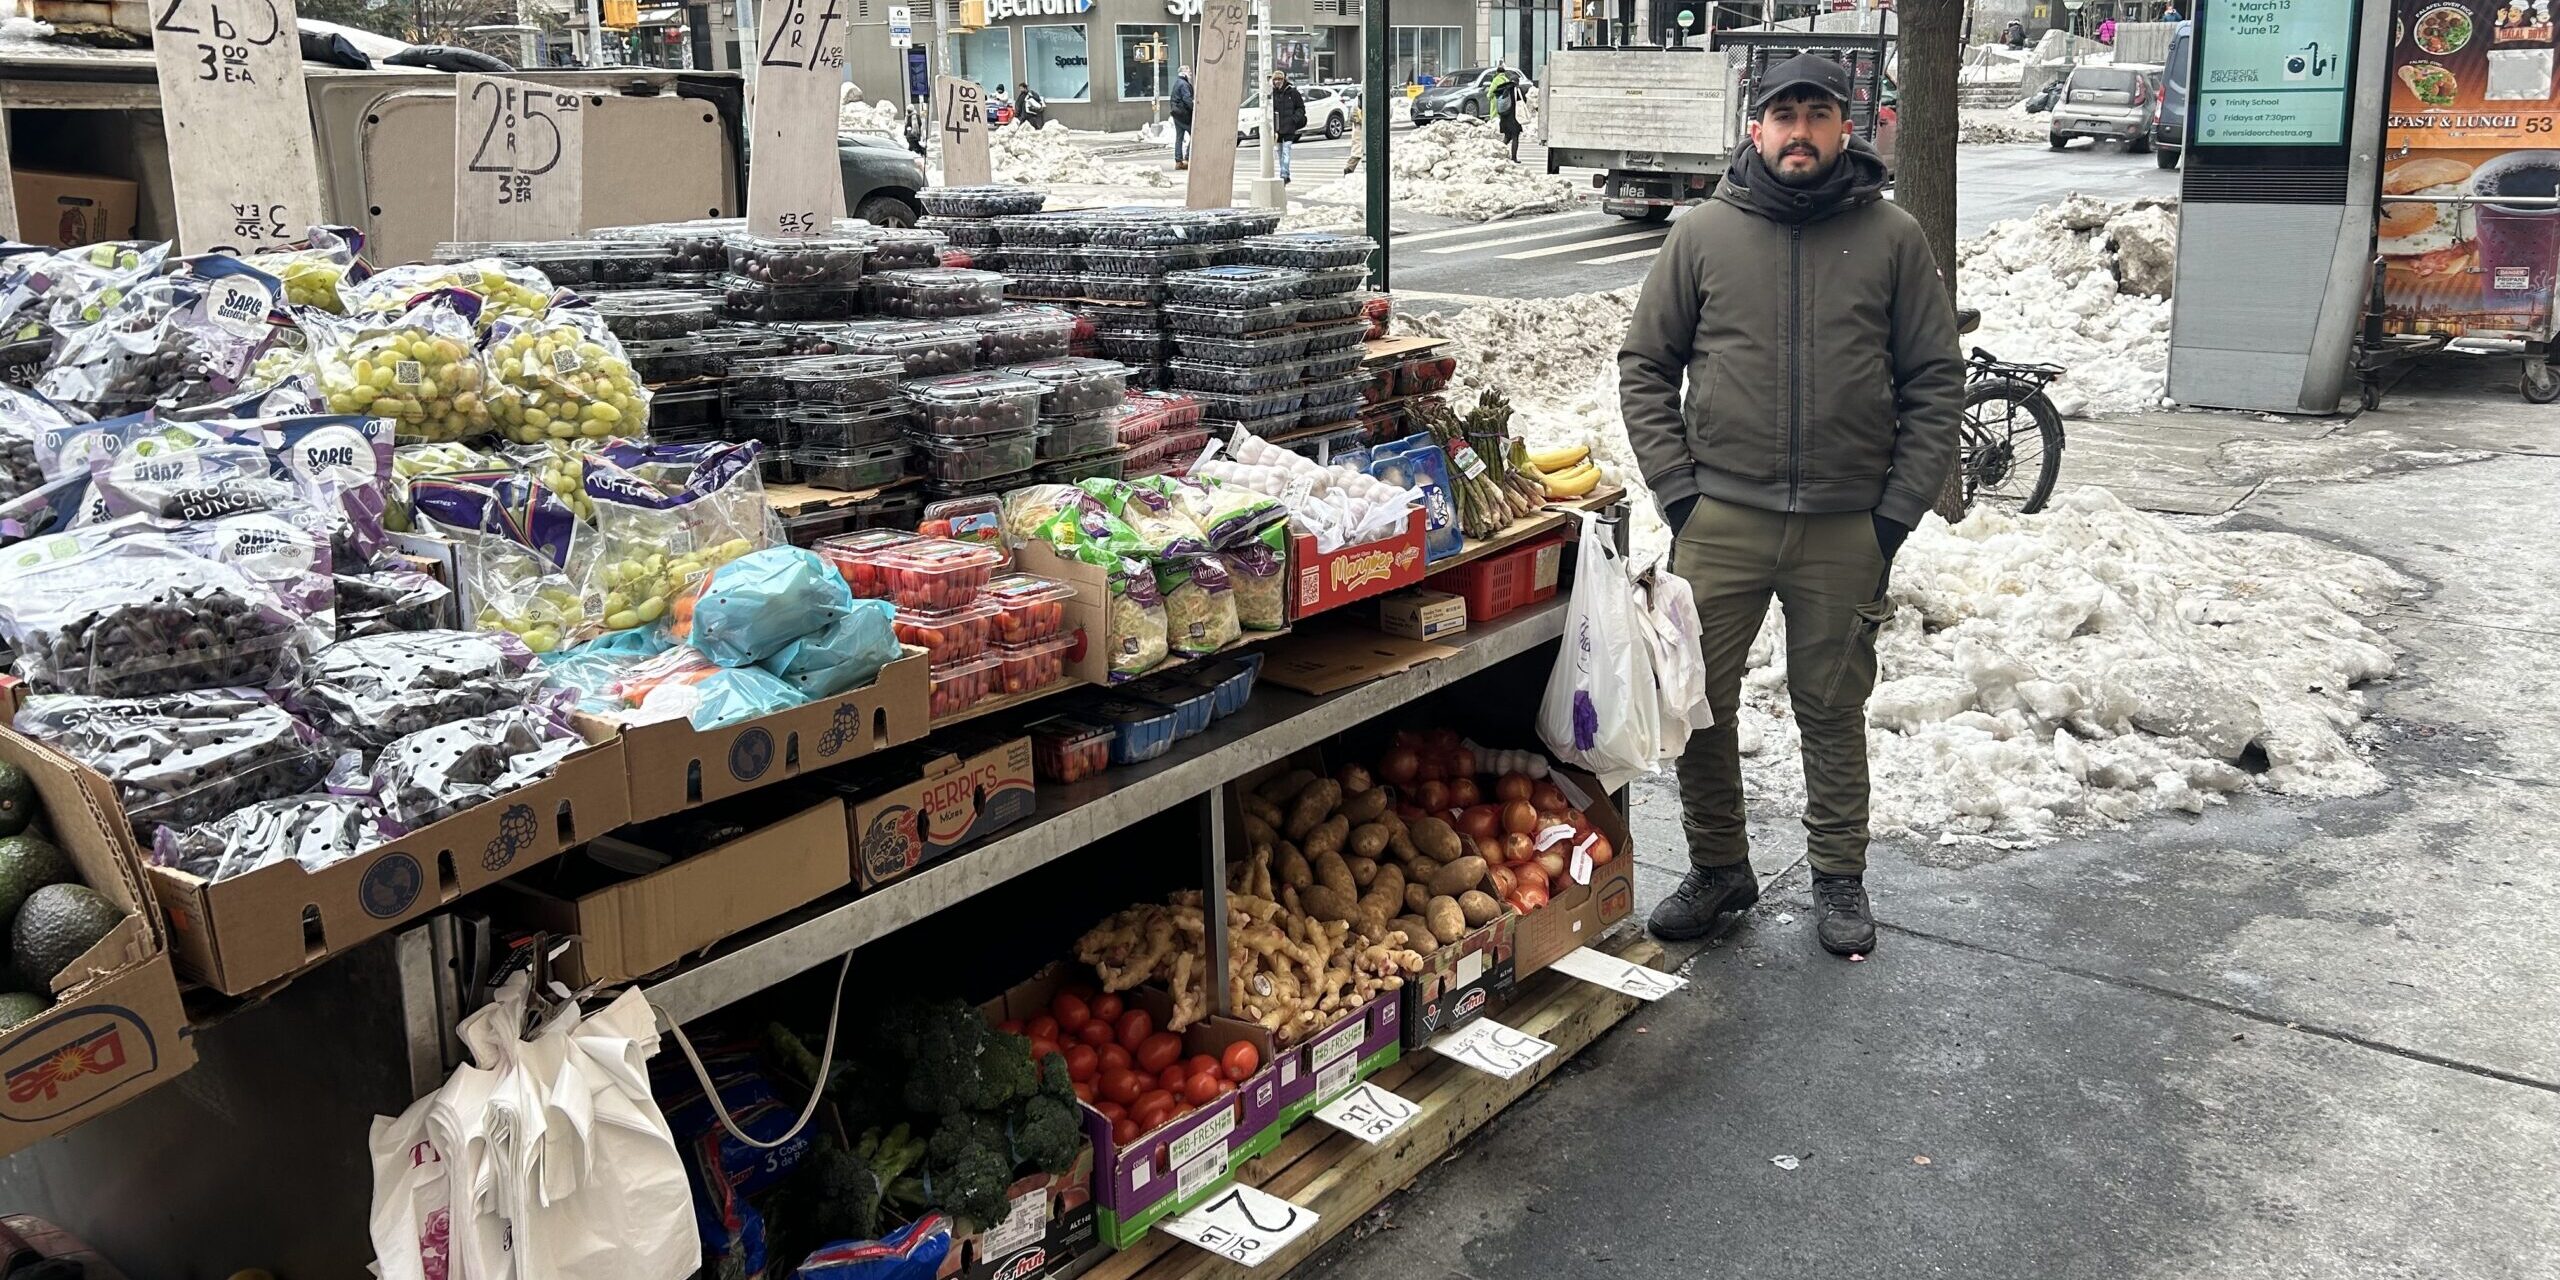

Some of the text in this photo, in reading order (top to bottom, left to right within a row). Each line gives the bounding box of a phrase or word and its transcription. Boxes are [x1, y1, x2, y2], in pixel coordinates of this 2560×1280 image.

[2239, 0, 2291, 11] March 13
[790, 0, 805, 48] OR
[2237, 25, 2280, 35] June 12
[2238, 13, 2274, 25] May 8
[1203, 5, 1226, 65] 3
[1227, 31, 1241, 51] EA
[198, 44, 218, 81] 3
[1055, 55, 1088, 68] Spectru
[2210, 75, 2259, 83] ORCHESTRA
[945, 83, 969, 144] 4
[2225, 98, 2279, 107] Trinity School
[963, 104, 982, 124] EA
[2223, 114, 2254, 123] Fridays
[2265, 114, 2296, 123] 7:30pm
[2439, 116, 2452, 128] &
[2455, 115, 2518, 128] LUNCH
[2525, 116, 2554, 134] 53
[469, 81, 514, 172] 2
[517, 90, 562, 175] 5
[2222, 129, 2313, 139] riversideorchestra.org
[498, 174, 513, 205] 3
[515, 188, 532, 203] EA
[269, 204, 291, 239] 3
[183, 490, 261, 521] PUNCH
[922, 764, 998, 816] BERRIES
[1322, 1028, 1356, 1057] B-FRESH
[1343, 1085, 1411, 1120] 2
[1183, 1116, 1223, 1153] B-FRESH
[764, 1151, 779, 1173] 3
[1132, 1154, 1149, 1170] COUNT
[1205, 1188, 1297, 1232] 2
